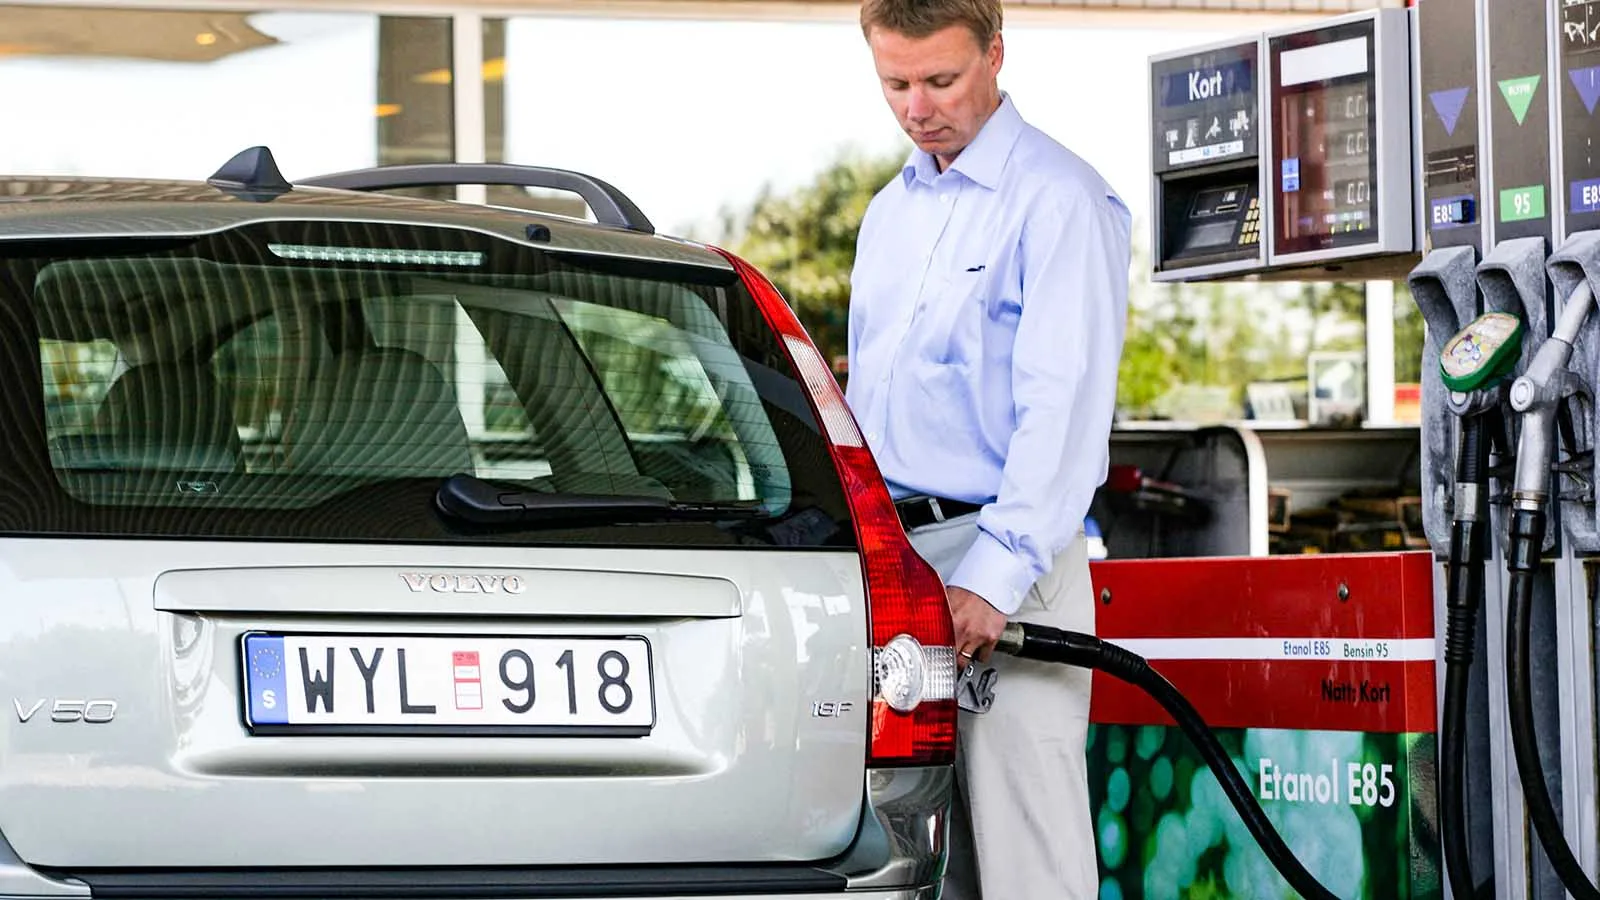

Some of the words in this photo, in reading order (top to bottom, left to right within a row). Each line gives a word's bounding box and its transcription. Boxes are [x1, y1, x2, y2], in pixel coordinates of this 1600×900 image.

[1188, 71, 1223, 101] Kort
[1514, 193, 1531, 214] 95
[398, 573, 526, 595] VOLVO
[1283, 640, 1312, 656] Etanol
[1314, 640, 1331, 656] E85
[1343, 643, 1374, 658] Bensin
[1376, 643, 1389, 658] 95
[298, 647, 437, 715] WYL
[498, 648, 634, 715] 918
[1321, 680, 1357, 701] Natt:
[1360, 680, 1391, 702] Kort
[262, 691, 276, 709] S
[1259, 758, 1338, 804] Etanol
[1347, 763, 1396, 807] E85
